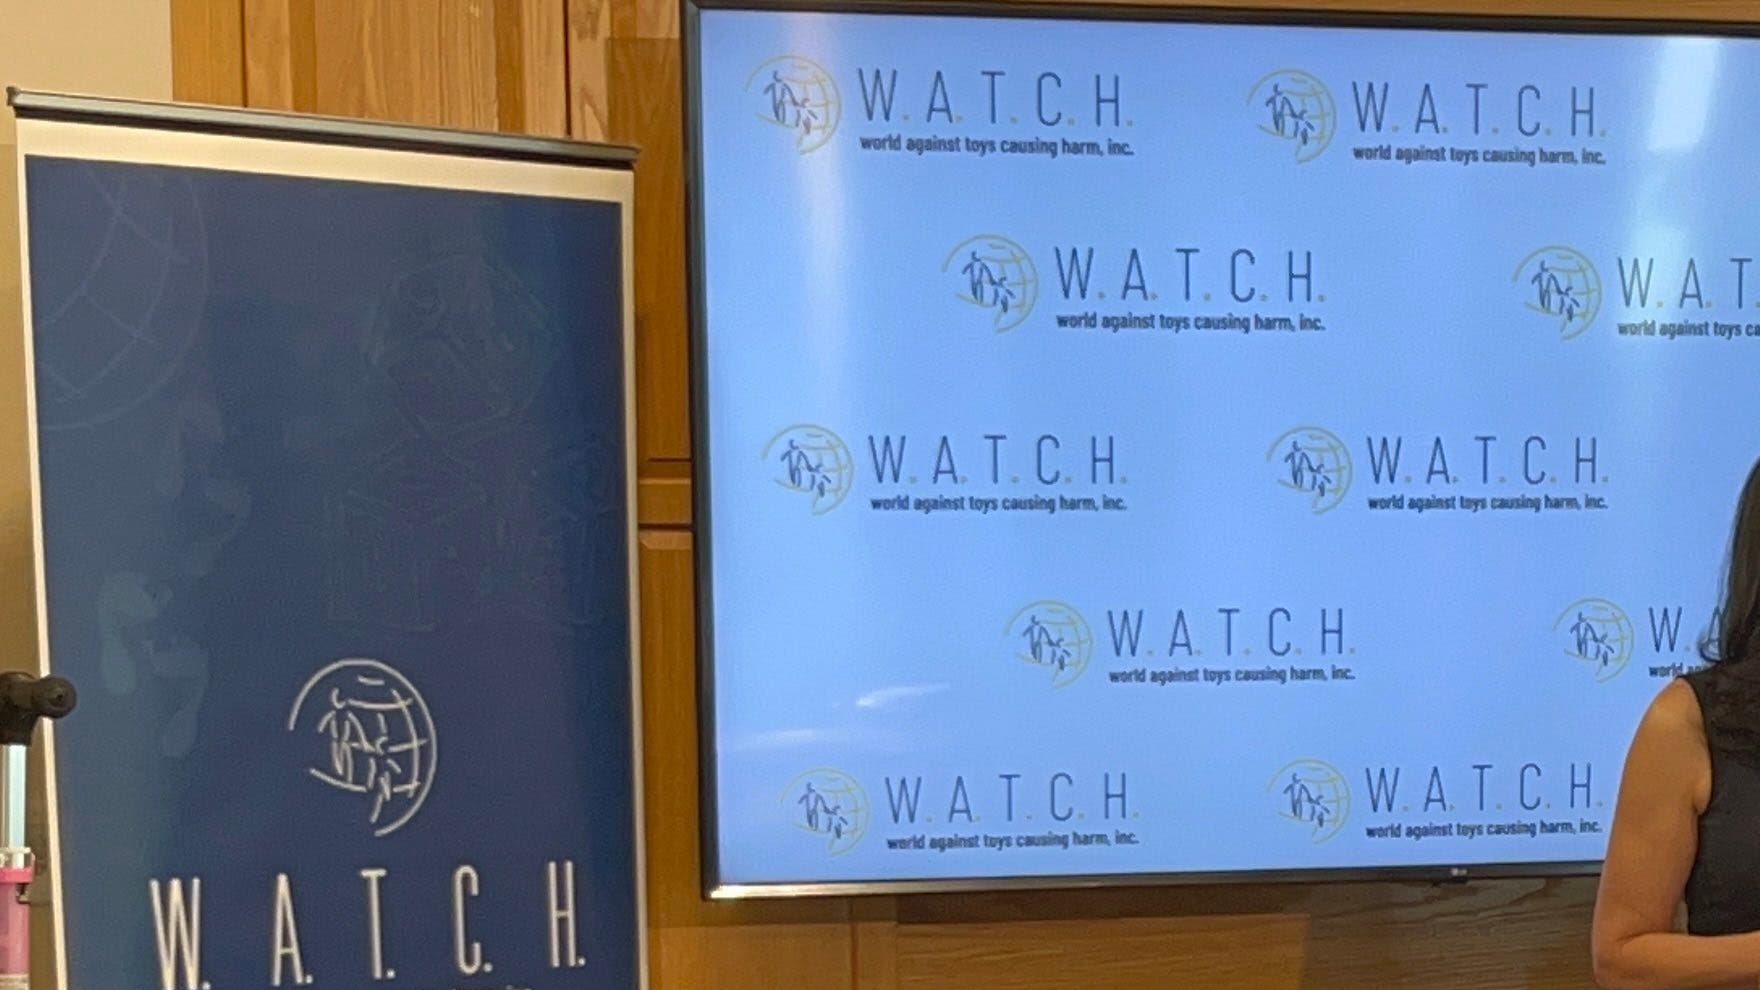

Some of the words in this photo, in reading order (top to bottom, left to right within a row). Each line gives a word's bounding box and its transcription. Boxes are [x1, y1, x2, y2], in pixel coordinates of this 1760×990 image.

[860, 134, 901, 151] world
[906, 135, 961, 156] against
[965, 137, 996, 157] toys
[1000, 137, 1058, 159] causing
[1353, 144, 1391, 160] world
[1395, 145, 1446, 164] against
[1450, 147, 1479, 166] toys
[1483, 148, 1535, 167] causing
[1056, 311, 1097, 329] world
[1101, 312, 1155, 333] against
[1159, 314, 1190, 333] toys
[1194, 313, 1250, 334] causing
[1618, 320, 1655, 335] world
[1660, 320, 1710, 340] against
[1713, 321, 1742, 340] toys
[871, 495, 909, 510] world
[914, 495, 965, 514] against
[968, 496, 998, 514] toys
[1002, 494, 1056, 514] causing
[1368, 494, 1404, 510] world
[1407, 494, 1456, 513] against
[1460, 496, 1487, 513] toys
[1491, 494, 1541, 513] causing
[1109, 668, 1146, 683] world
[1150, 667, 1199, 686] against
[1203, 668, 1231, 685] toys
[1235, 666, 1286, 684] causing
[1366, 823, 1401, 838] world
[1405, 822, 1453, 841] against
[1456, 823, 1483, 839] toys
[1486, 820, 1536, 838] causing
[887, 835, 925, 849] world
[929, 834, 980, 852] against
[983, 835, 1013, 851] toys
[1016, 831, 1069, 849] causing
